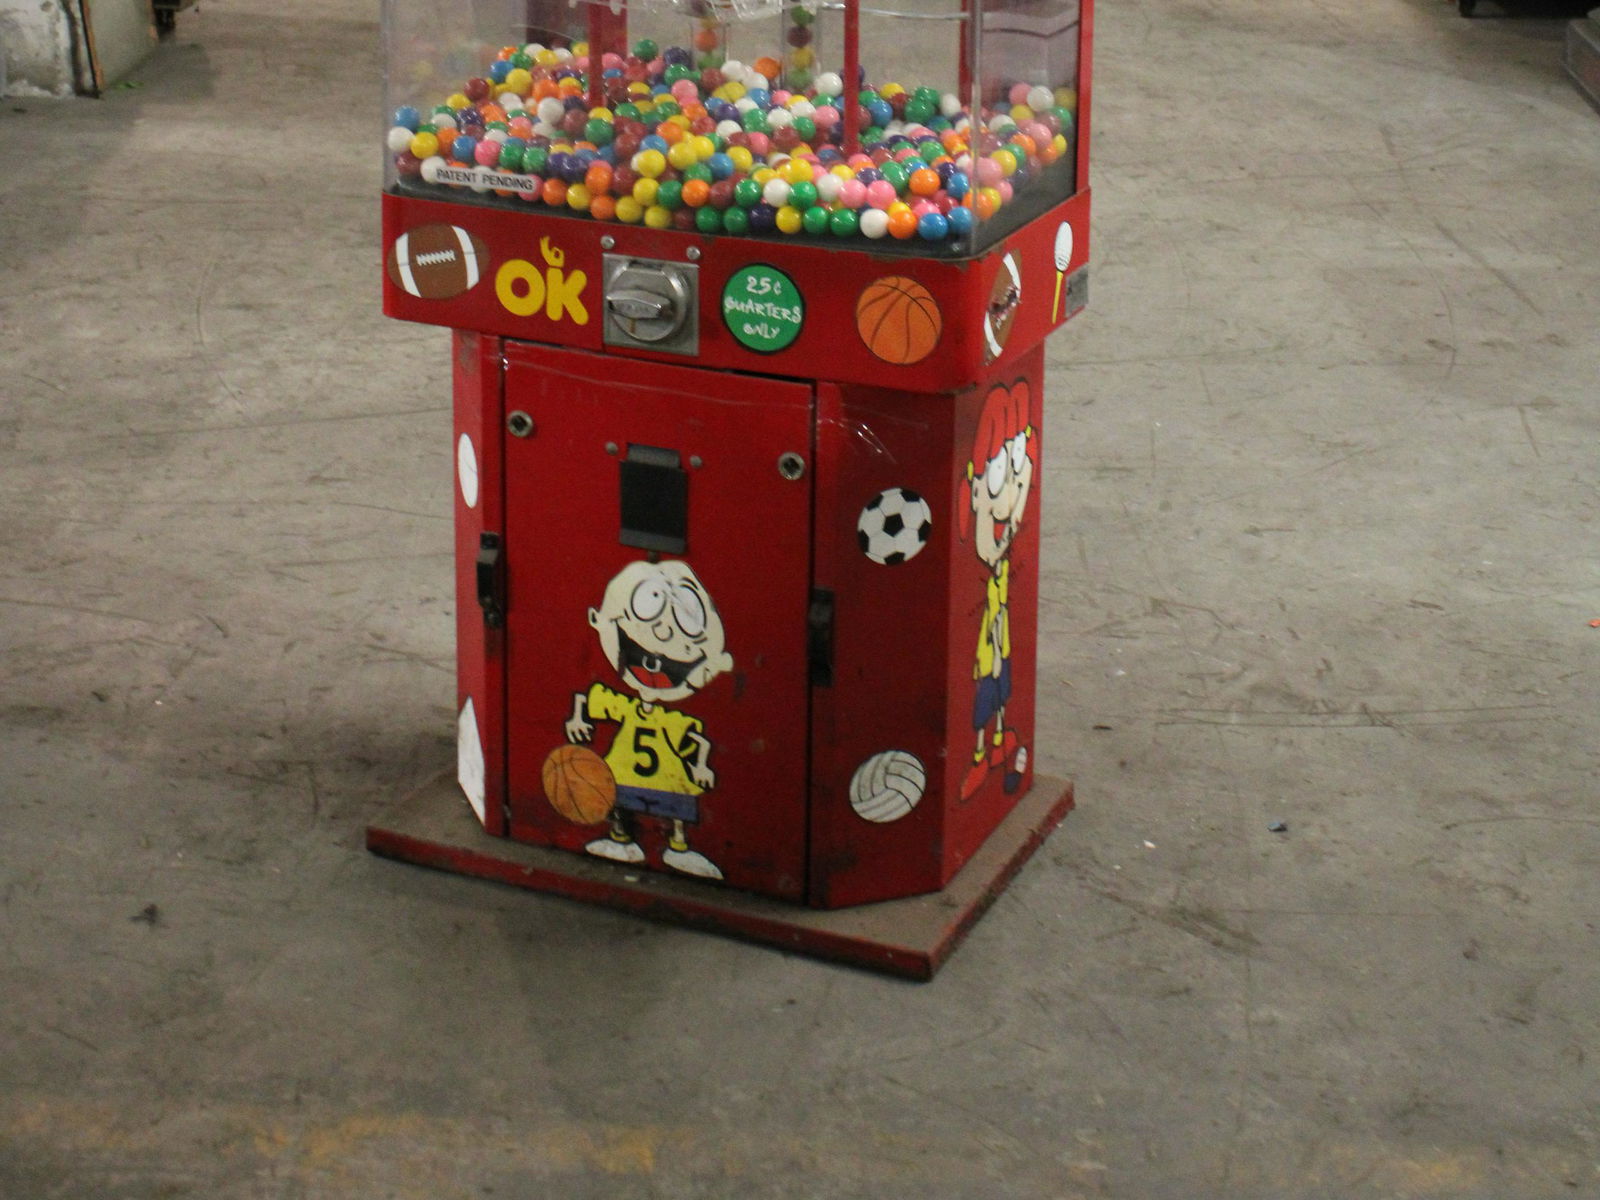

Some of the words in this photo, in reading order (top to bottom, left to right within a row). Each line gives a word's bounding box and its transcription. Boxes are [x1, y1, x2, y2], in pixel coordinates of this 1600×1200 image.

[436, 168, 477, 184] PATENT
[482, 173, 534, 191] PENDING
[494, 258, 590, 327] OK
[724, 295, 802, 324] QUARTERS
[743, 322, 780, 340] ONLY
[632, 726, 660, 778] 5
